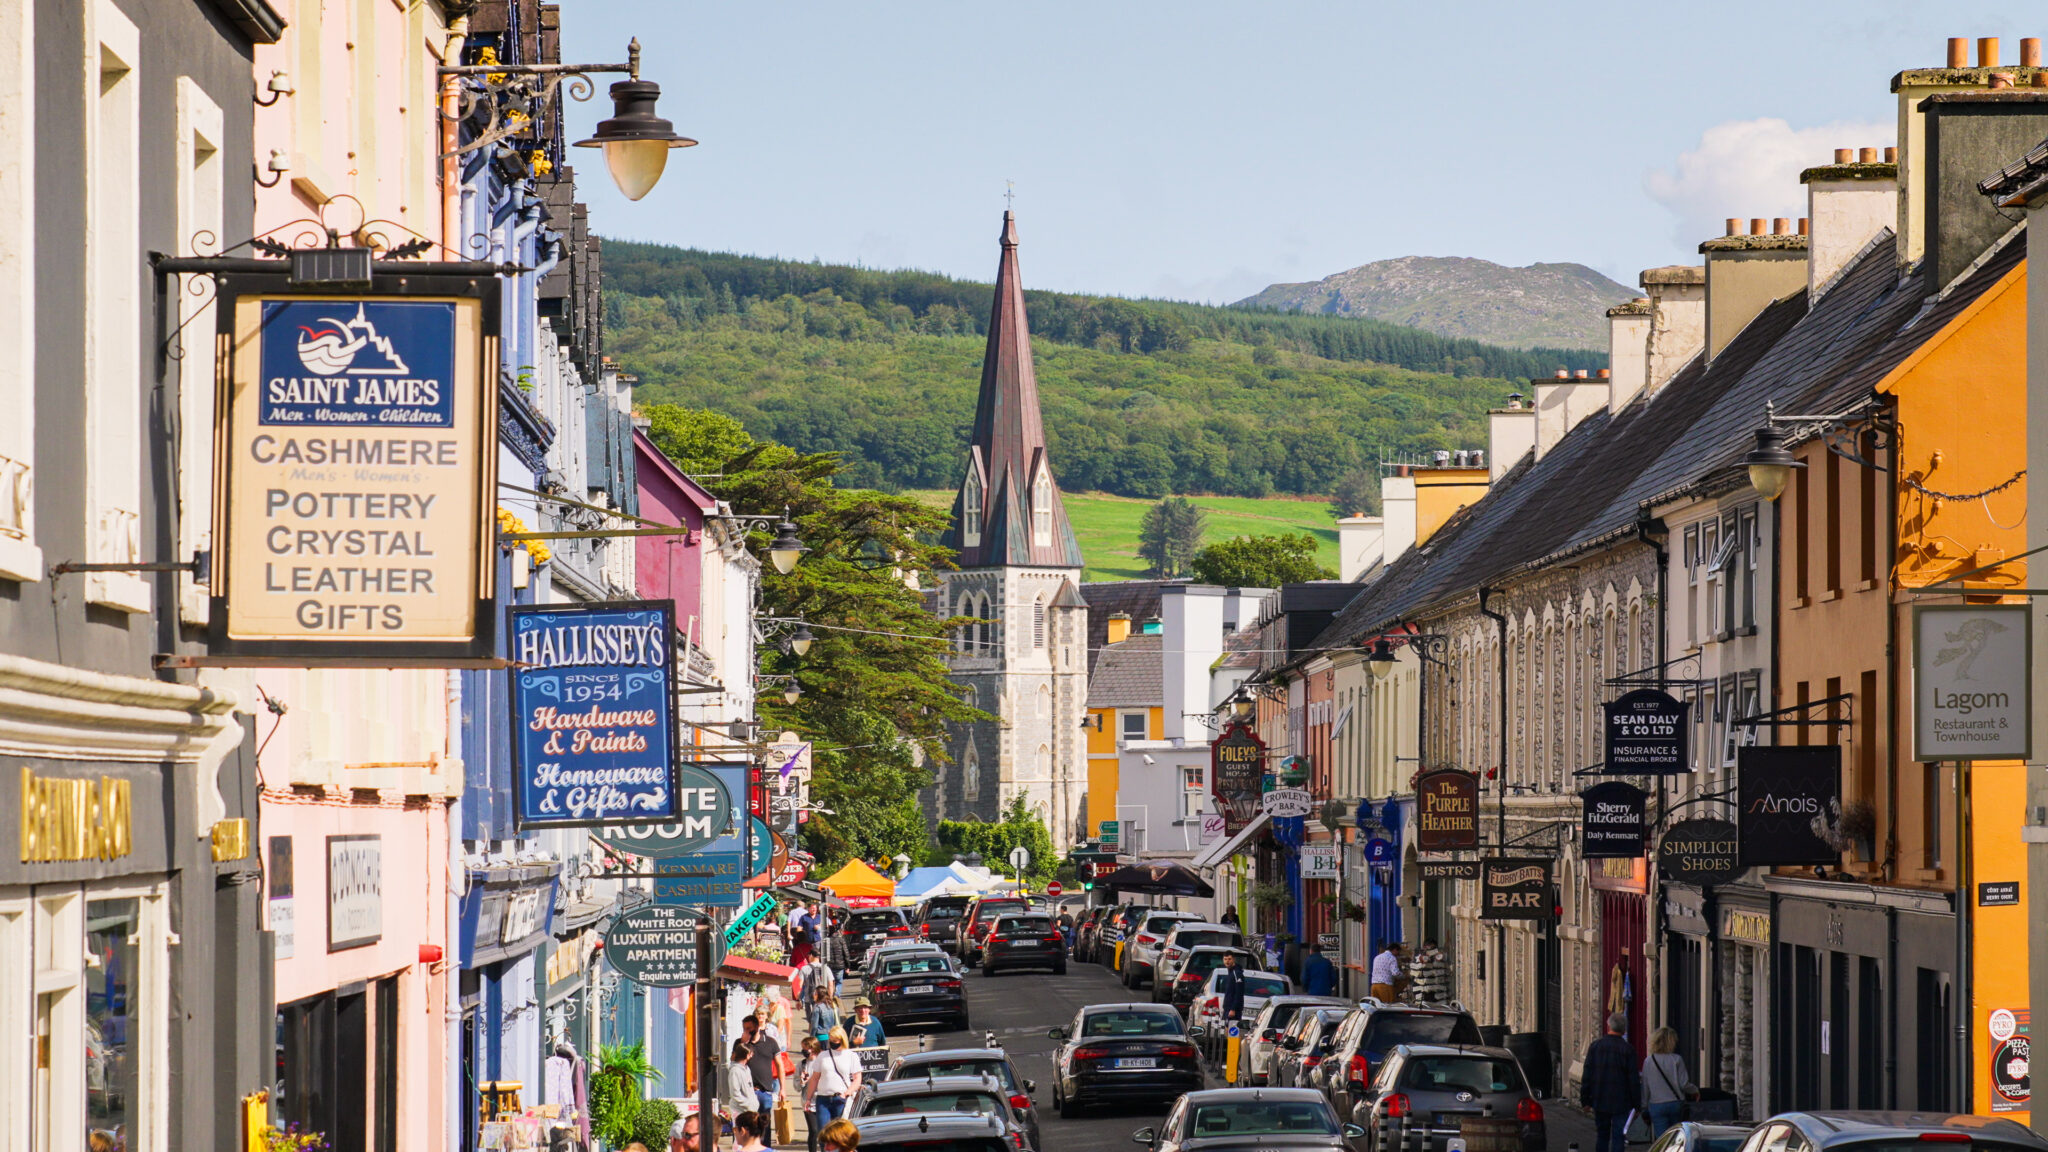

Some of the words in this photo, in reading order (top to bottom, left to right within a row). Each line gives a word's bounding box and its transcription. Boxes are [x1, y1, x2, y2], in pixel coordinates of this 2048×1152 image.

[269, 378, 350, 404] SAINT
[354, 379, 440, 406] JAMES
[269, 408, 304, 421] Men
[315, 409, 368, 422] Women
[379, 409, 443, 423] Children
[251, 435, 458, 465] CASHMERE
[290, 469, 337, 481] Men's
[354, 470, 421, 482] Women's
[267, 489, 436, 519] POTTERY
[267, 525, 433, 556] CRYSTAL
[266, 563, 434, 593] LEATHER
[297, 600, 403, 630] GIFTS
[519, 622, 665, 672] HALLISSEY'S
[565, 674, 620, 683] SINCE
[565, 685, 623, 703] 1954
[1935, 688, 2009, 714] Lagom
[530, 705, 657, 731] Hardware
[1614, 716, 1646, 725] SEAN
[1649, 715, 1679, 725] DALY
[1935, 719, 1996, 730] Restaurant
[1999, 718, 2009, 729] &
[1622, 726, 1630, 735] &
[1634, 726, 1649, 735] CO
[1653, 726, 1674, 735] LTD
[1935, 731, 2000, 742] Townhouse
[544, 731, 565, 755] &
[572, 730, 648, 754] Paints
[1614, 747, 1668, 755] INSURANCE
[1672, 747, 1678, 755] &
[534, 763, 667, 788] Homeware
[1440, 782, 1459, 795] The
[540, 789, 562, 813] &
[566, 786, 629, 818] Gifts
[1265, 791, 1310, 804] CROWLEY'S
[1427, 793, 1470, 812] PURPLE
[1748, 793, 1818, 813] Anois
[1597, 803, 1631, 815] Sherry
[603, 816, 712, 840] ROOM
[1422, 813, 1473, 831] HEATHER
[1588, 832, 1603, 841] Daly
[1606, 832, 1639, 840] Kenmare
[1374, 846, 1383, 856] B
[1664, 842, 1737, 855] SIMPLICIT
[659, 863, 737, 875] KENMARE
[1682, 857, 1731, 871] SHOES
[1424, 866, 1474, 877] BISTRO
[1491, 872, 1518, 884] FLORRY
[654, 883, 742, 897] CASHMERE
[1492, 893, 1541, 908] BAR
[652, 909, 675, 918] THE
[627, 919, 666, 929] WHITE
[726, 919, 751, 944] TAKE
[753, 897, 773, 918] OUT
[613, 933, 662, 945] LUXURY
[665, 932, 717, 945] HOLIY
[627, 949, 697, 961] APARTMENT
[639, 972, 671, 983] Enquire
[1993, 1021, 2012, 1029] PYRO
[2007, 1040, 2028, 1048] PIZZA
[2013, 1048, 2030, 1056] PAST
